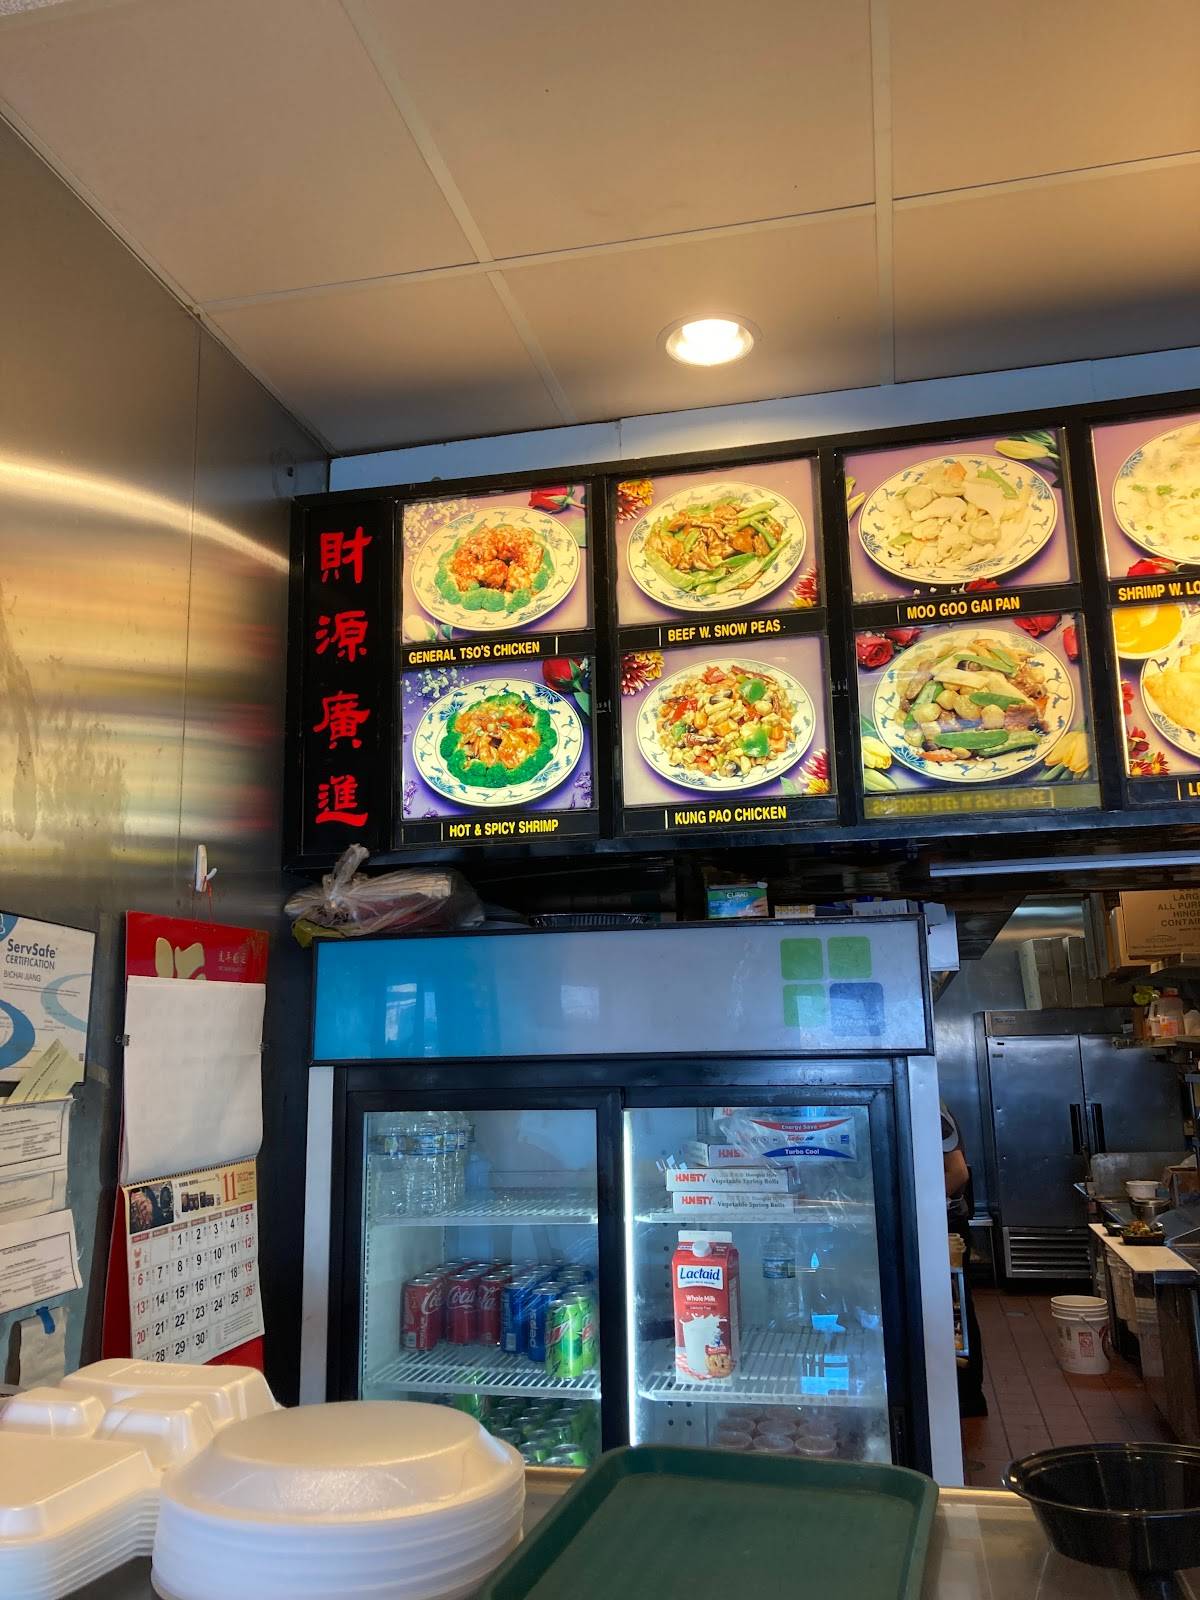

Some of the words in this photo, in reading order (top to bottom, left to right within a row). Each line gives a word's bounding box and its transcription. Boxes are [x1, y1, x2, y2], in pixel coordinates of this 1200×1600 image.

[1119, 584, 1165, 601] SHRIMP
[1169, 583, 1183, 596] W.
[907, 605, 935, 619] MOO
[940, 602, 967, 616] GOO
[971, 599, 992, 613] GAI
[996, 597, 1019, 610] PAN
[668, 628, 695, 641] BEEF
[699, 627, 711, 638] W.
[714, 623, 747, 637] SNOW
[751, 619, 780, 633] PEAS
[409, 649, 456, 664] GENERAL
[460, 645, 490, 659] TSO'S
[494, 642, 539, 656] CHICKEN
[675, 811, 706, 824] KUNG
[709, 809, 731, 822] PAO
[735, 806, 786, 821] CHICKEN
[450, 824, 471, 837] HOT
[475, 824, 481, 836] &
[485, 822, 515, 835] SPICY
[519, 819, 558, 833] SHRIMP
[1158, 903, 1176, 911] ALL
[7, 939, 56, 958] ServSafe
[6, 955, 55, 969] CERTIFICATION
[223, 1172, 237, 1203] 11
[177, 1234, 182, 1245] 1
[196, 1228, 201, 1240] 2
[214, 1224, 219, 1234] 3
[230, 1219, 235, 1229] 4
[245, 1214, 249, 1224] 5
[138, 1274, 143, 1286] 6
[158, 1266, 162, 1279] 7
[178, 1261, 182, 1272] 8
[196, 1254, 201, 1266] 9
[214, 1248, 222, 1259] 10
[230, 1244, 237, 1254] 11
[244, 1238, 252, 1248] 12
[679, 1268, 720, 1280] Lactaid
[137, 1301, 145, 1315] 13
[155, 1295, 165, 1307] 14
[175, 1287, 185, 1300] 15
[195, 1280, 204, 1292] 16
[214, 1273, 222, 1285] 17
[230, 1268, 237, 1279] 18
[245, 1262, 252, 1272] 19
[137, 1331, 145, 1344] 20
[155, 1324, 164, 1337] 21
[175, 1315, 185, 1328] 22
[195, 1307, 204, 1319] 23
[214, 1299, 222, 1311] 24
[231, 1294, 239, 1304] 25
[246, 1286, 253, 1297] 26
[155, 1349, 165, 1362] 28
[175, 1341, 185, 1355] 29
[195, 1332, 205, 1346] 30
